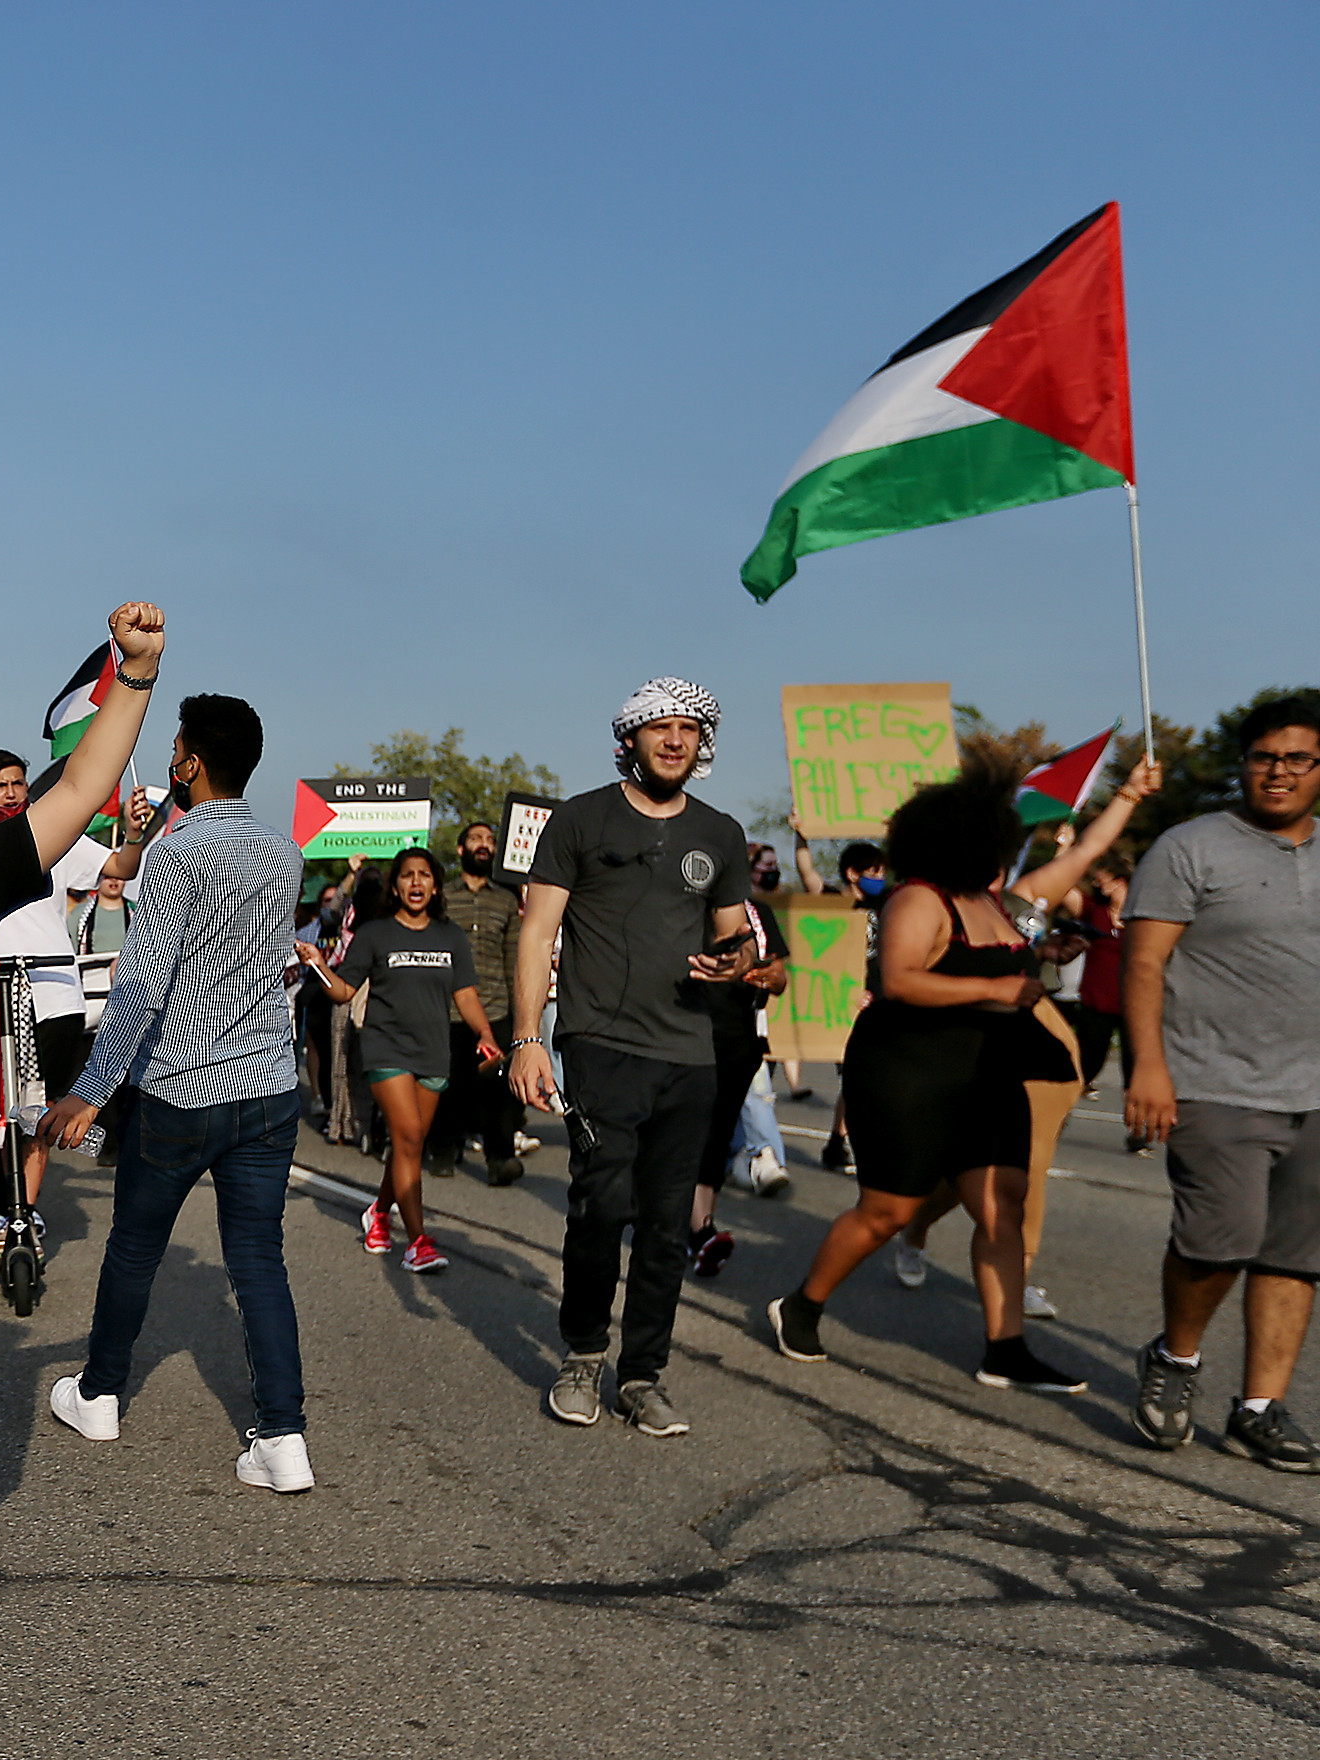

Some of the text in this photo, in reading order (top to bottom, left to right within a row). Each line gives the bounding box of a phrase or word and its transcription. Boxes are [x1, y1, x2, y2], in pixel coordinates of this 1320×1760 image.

[335, 783, 408, 797] END THE
[339, 810, 418, 821] PALESTINIAN
[323, 837, 402, 848] HOLOCAUST
